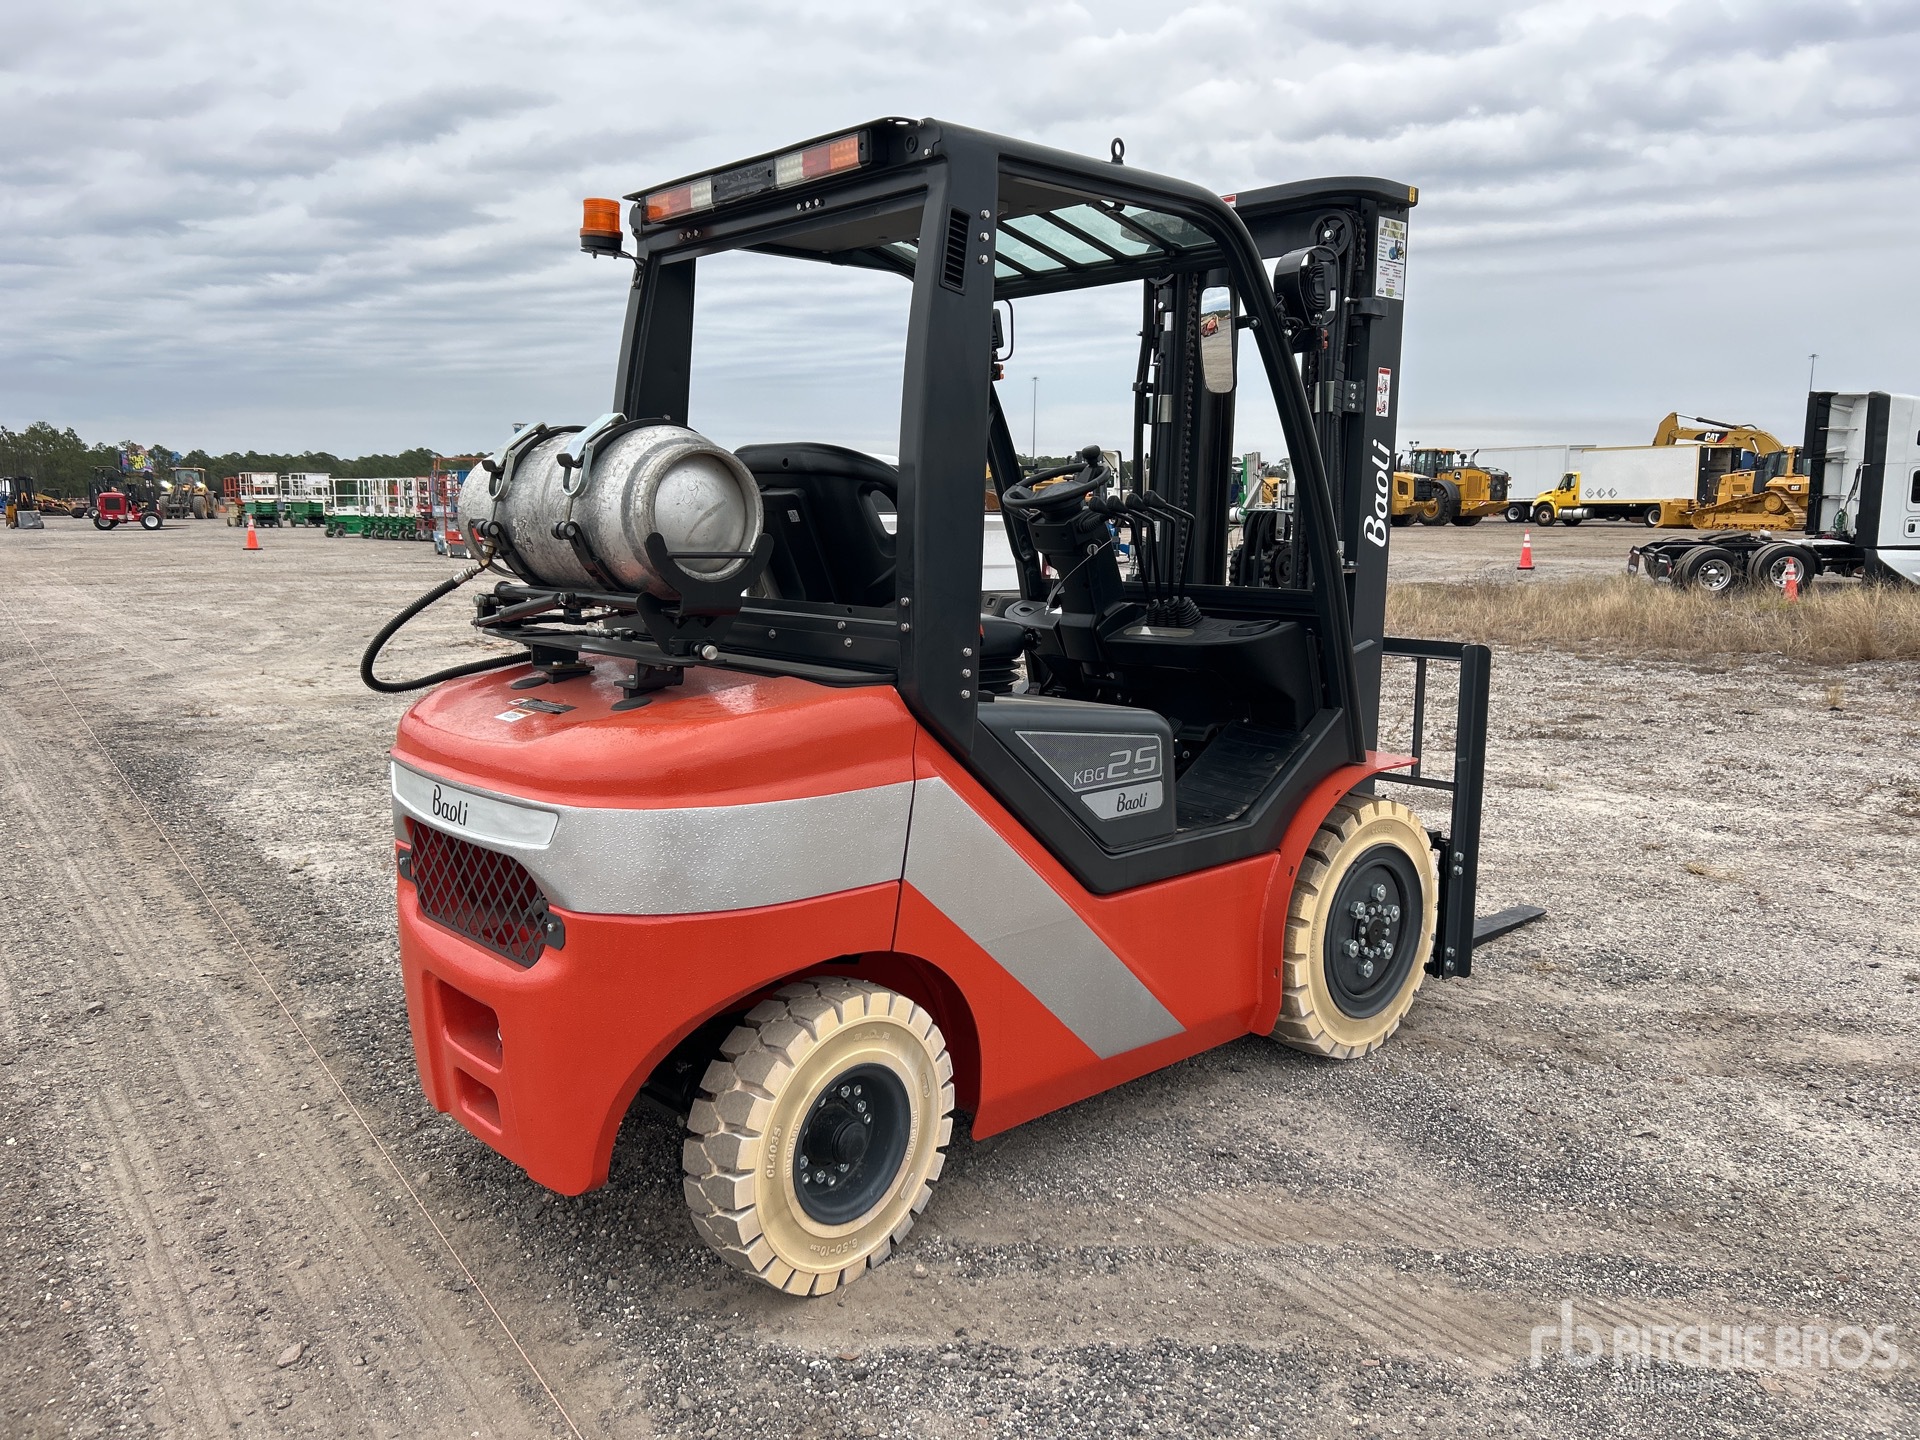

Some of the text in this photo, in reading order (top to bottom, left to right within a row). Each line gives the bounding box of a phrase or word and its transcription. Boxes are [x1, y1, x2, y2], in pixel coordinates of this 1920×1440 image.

[1704, 432, 1720, 443] CAT
[1363, 438, 1391, 548] Baoli
[432, 784, 469, 826] Baoli
[1116, 792, 1148, 813] Baoli
[765, 1125, 783, 1179] CL403S
